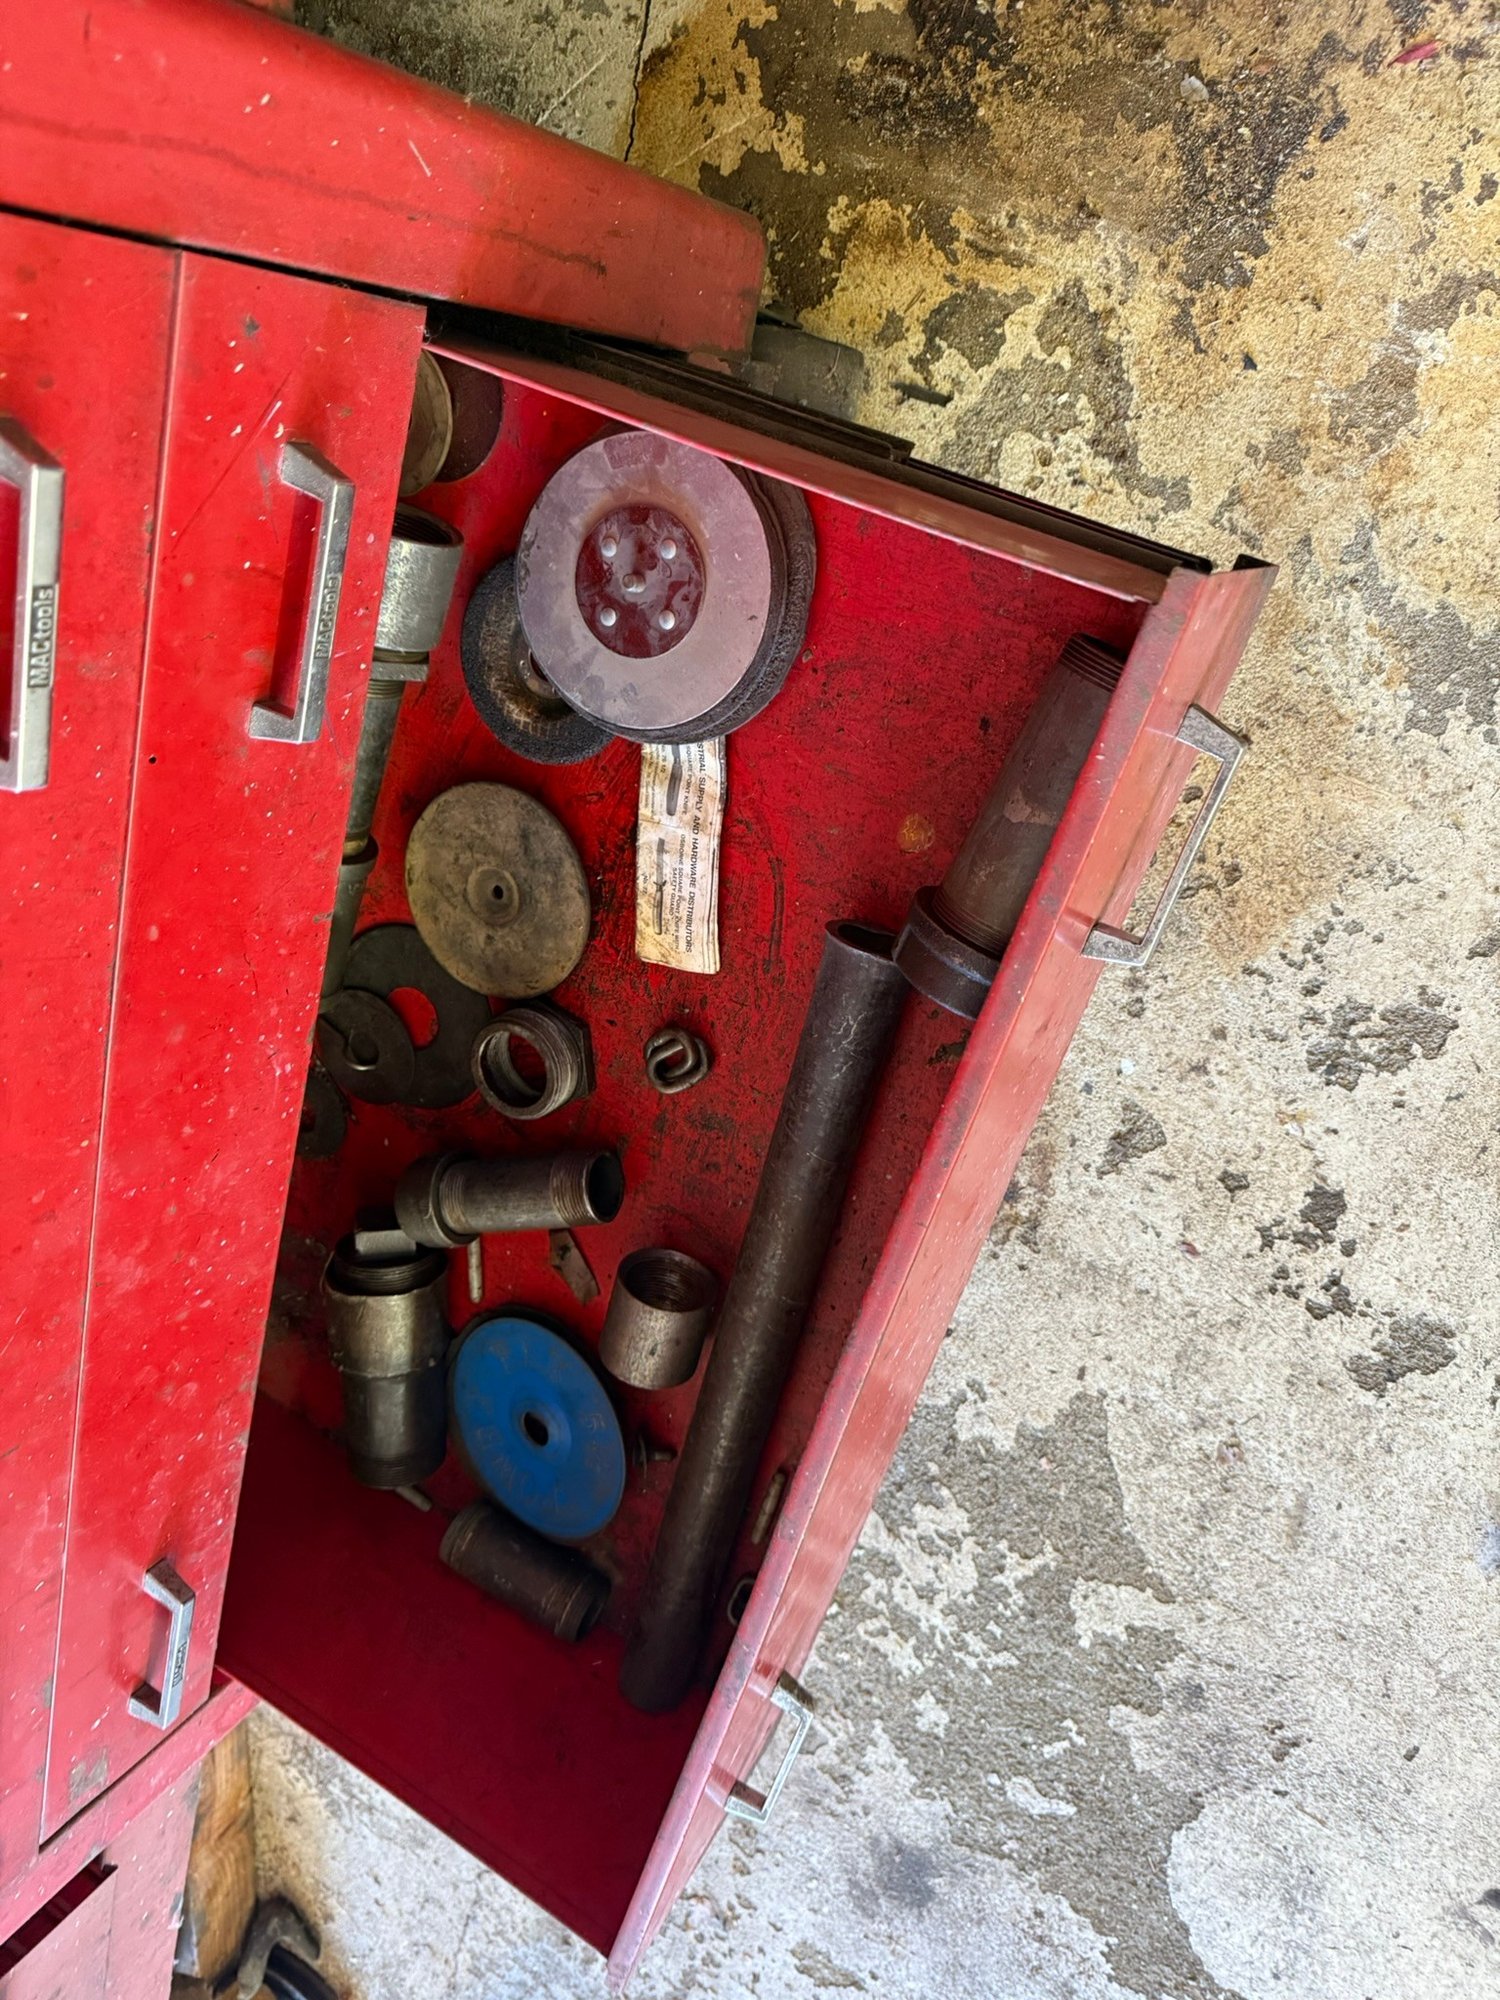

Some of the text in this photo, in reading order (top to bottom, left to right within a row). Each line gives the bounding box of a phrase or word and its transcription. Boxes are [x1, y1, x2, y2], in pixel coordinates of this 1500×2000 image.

[681, 745, 693, 815] SQUARE POINT KNIFE
[695, 777, 705, 812] SUPPLY
[692, 815, 700, 834] AND
[678, 833, 686, 865] OSBORNE
[688, 838, 699, 888] HARDWARE
[668, 892, 676, 916] GUARD
[674, 894, 682, 914] POINT
[685, 892, 695, 952] DISTRIBUTORS
